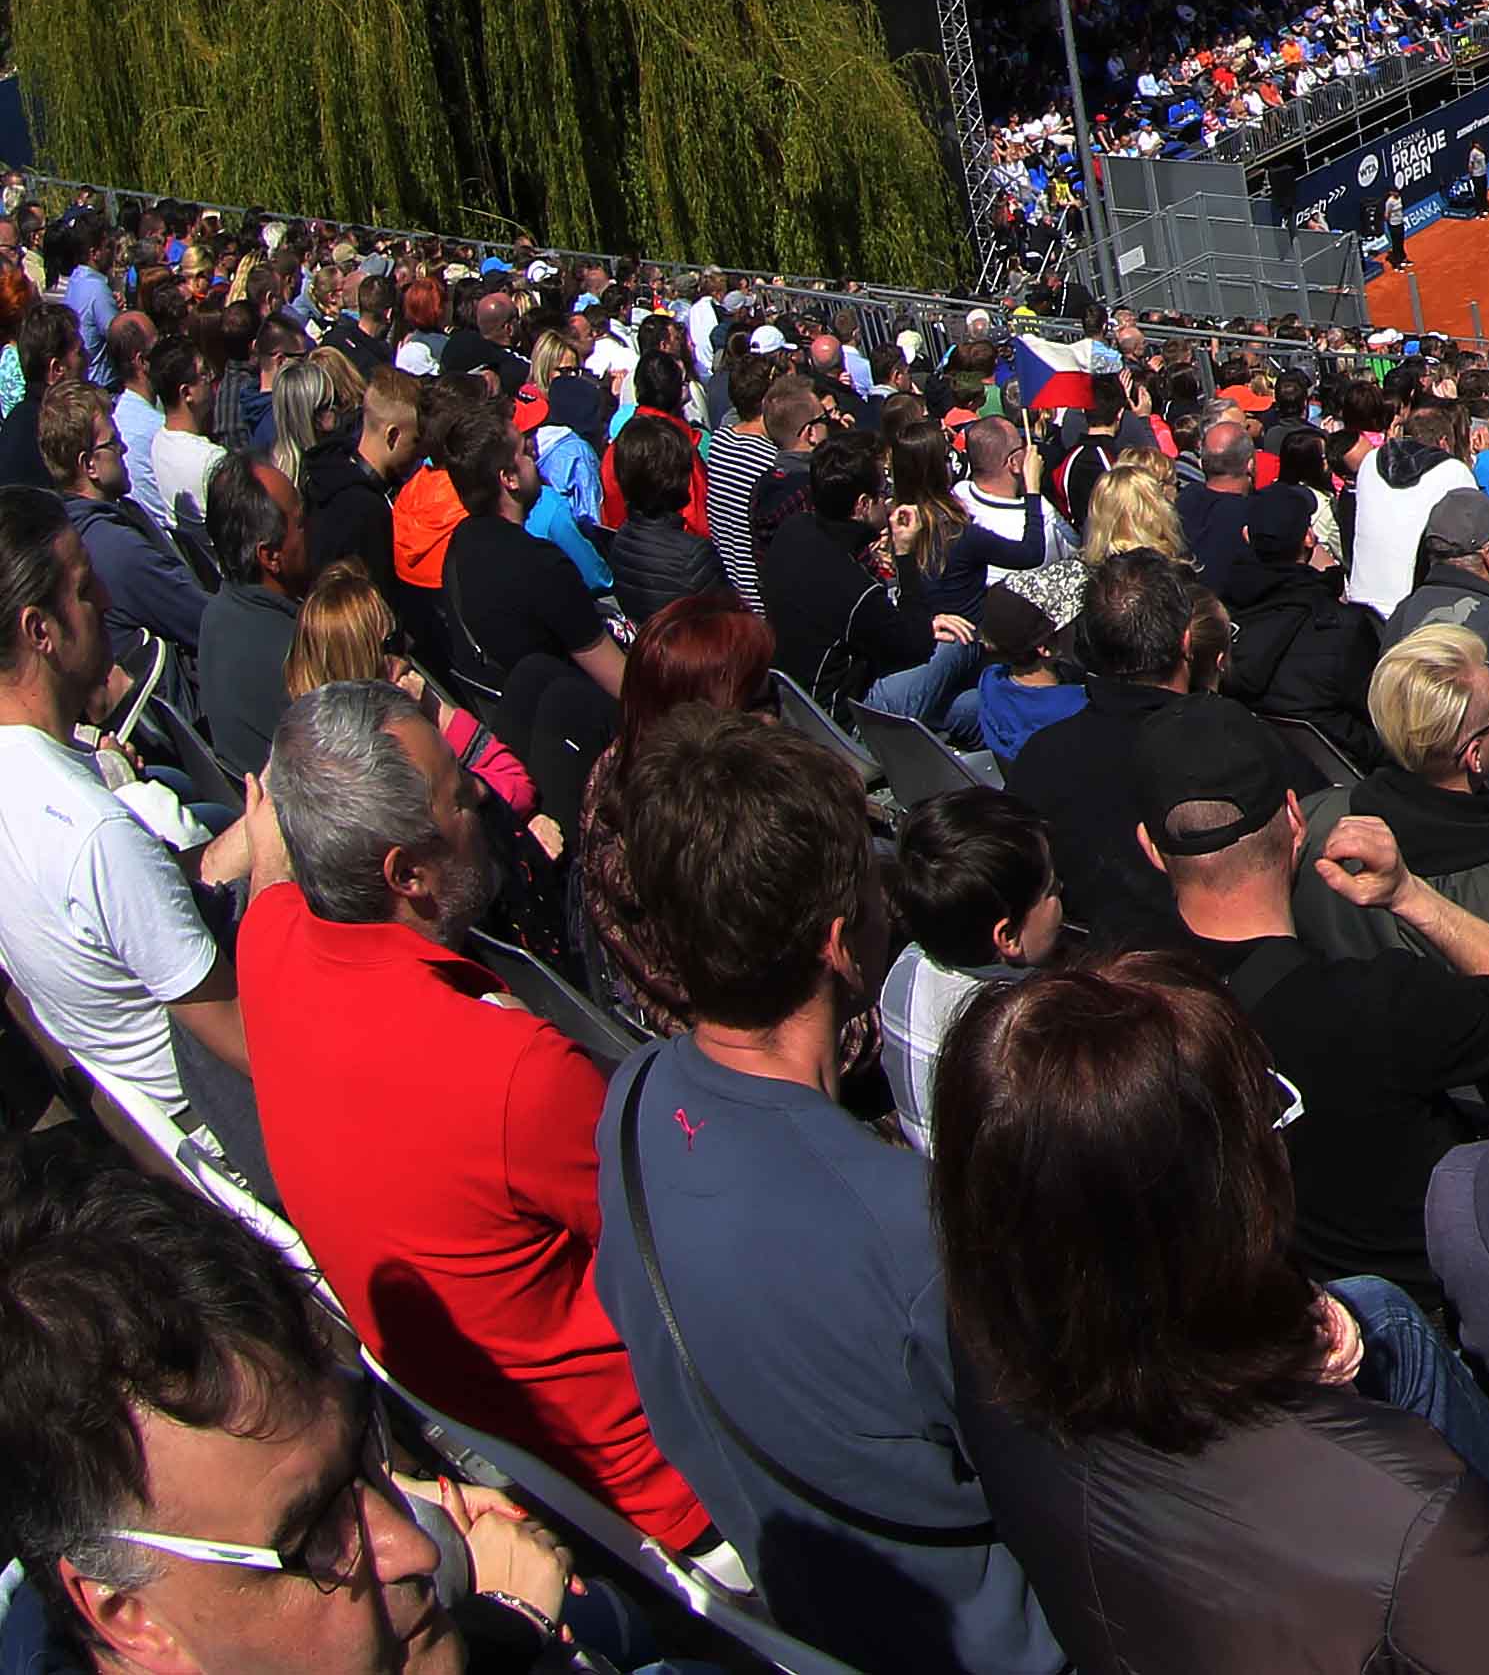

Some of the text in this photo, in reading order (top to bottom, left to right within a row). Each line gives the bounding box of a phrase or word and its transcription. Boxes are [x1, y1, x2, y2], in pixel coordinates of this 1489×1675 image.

[1391, 129, 1448, 174] PRAGUE
[1394, 157, 1433, 190] OPEN
[1281, 199, 1327, 229] kpsch
[1410, 200, 1442, 227] BANKA
